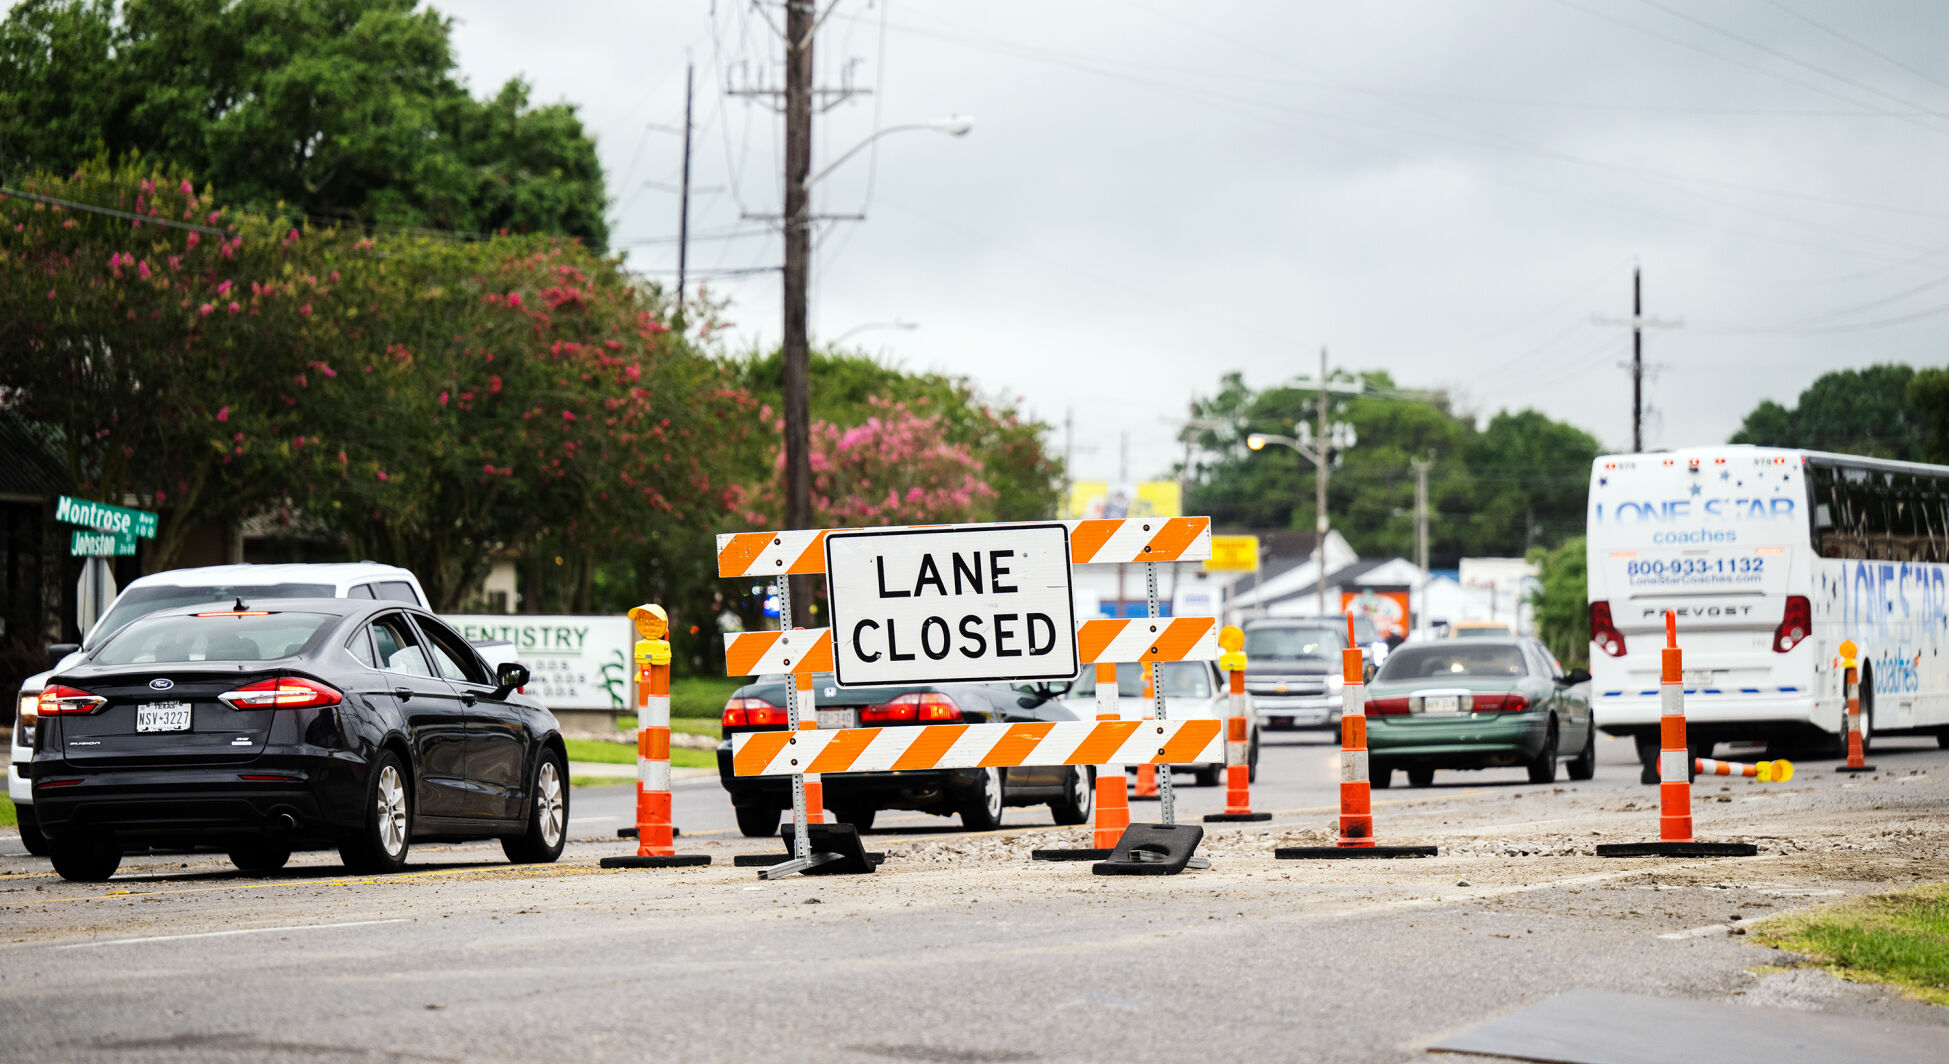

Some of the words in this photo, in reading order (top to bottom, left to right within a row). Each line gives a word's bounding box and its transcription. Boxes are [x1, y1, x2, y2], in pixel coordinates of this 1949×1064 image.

[56, 495, 131, 533] Montrose
[1596, 500, 1690, 524] LONE
[1704, 498, 1795, 522] STAR
[71, 530, 116, 556] Johnston
[1653, 528, 1737, 544] coaches
[876, 550, 1018, 598] LANE
[1627, 557, 1764, 576] 800-933-1132
[1629, 574, 1762, 586] LoneStarCoaches.com
[852, 612, 1056, 663] CLOSED
[1875, 647, 1919, 693] coaches
